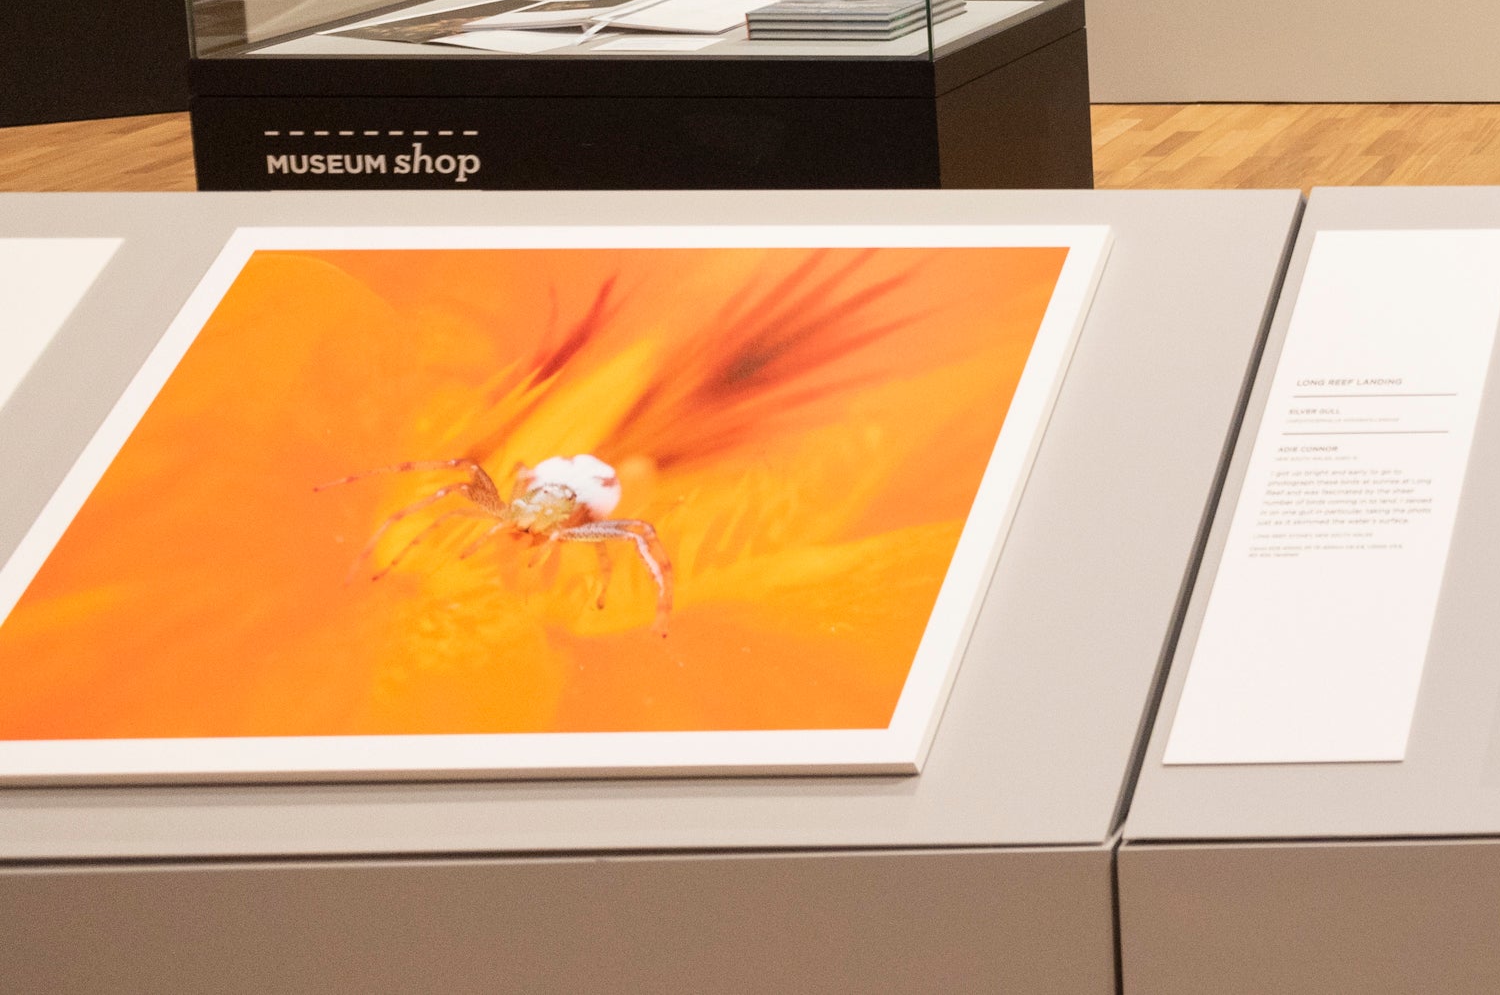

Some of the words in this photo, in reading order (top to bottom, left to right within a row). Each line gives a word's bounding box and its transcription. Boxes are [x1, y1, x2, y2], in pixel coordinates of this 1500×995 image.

[266, 155, 387, 174] MUSEUM
[393, 143, 481, 182] shop
[1357, 378, 1403, 386] LANDING
